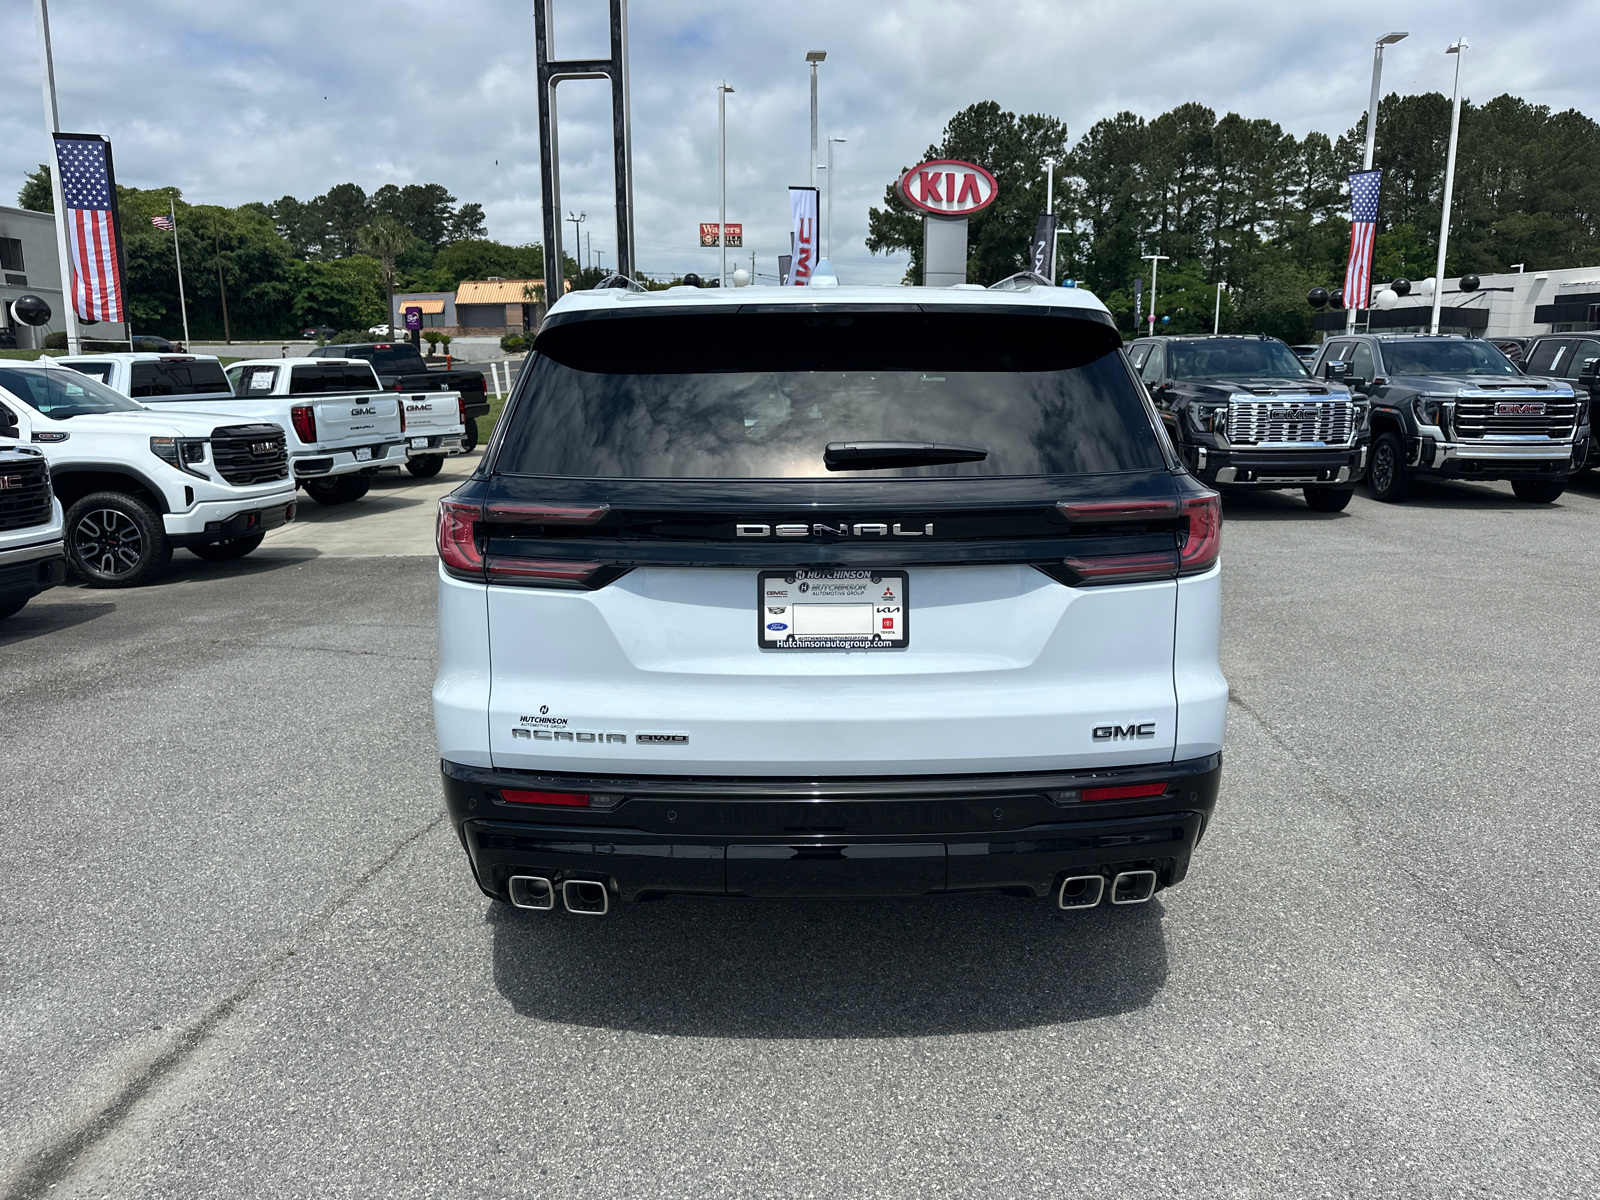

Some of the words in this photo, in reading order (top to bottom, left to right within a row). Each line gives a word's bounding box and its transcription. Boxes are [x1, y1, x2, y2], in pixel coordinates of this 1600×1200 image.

[919, 171, 982, 204] KIA
[702, 224, 741, 234] Waers
[351, 407, 377, 417] GMC
[406, 404, 433, 412] GMC
[1499, 404, 1544, 413] GMC
[1271, 409, 1318, 419] GMC
[736, 523, 934, 537] DENALI
[807, 570, 872, 579] HUTCHINSON
[811, 583, 868, 591] HUTCHINSON
[777, 640, 892, 649] Hutchinsonautogroup.com
[520, 715, 568, 725] HUTCHINSON
[511, 728, 627, 744] ACADIA
[637, 734, 688, 743] AWD
[1092, 722, 1156, 740] GMC
